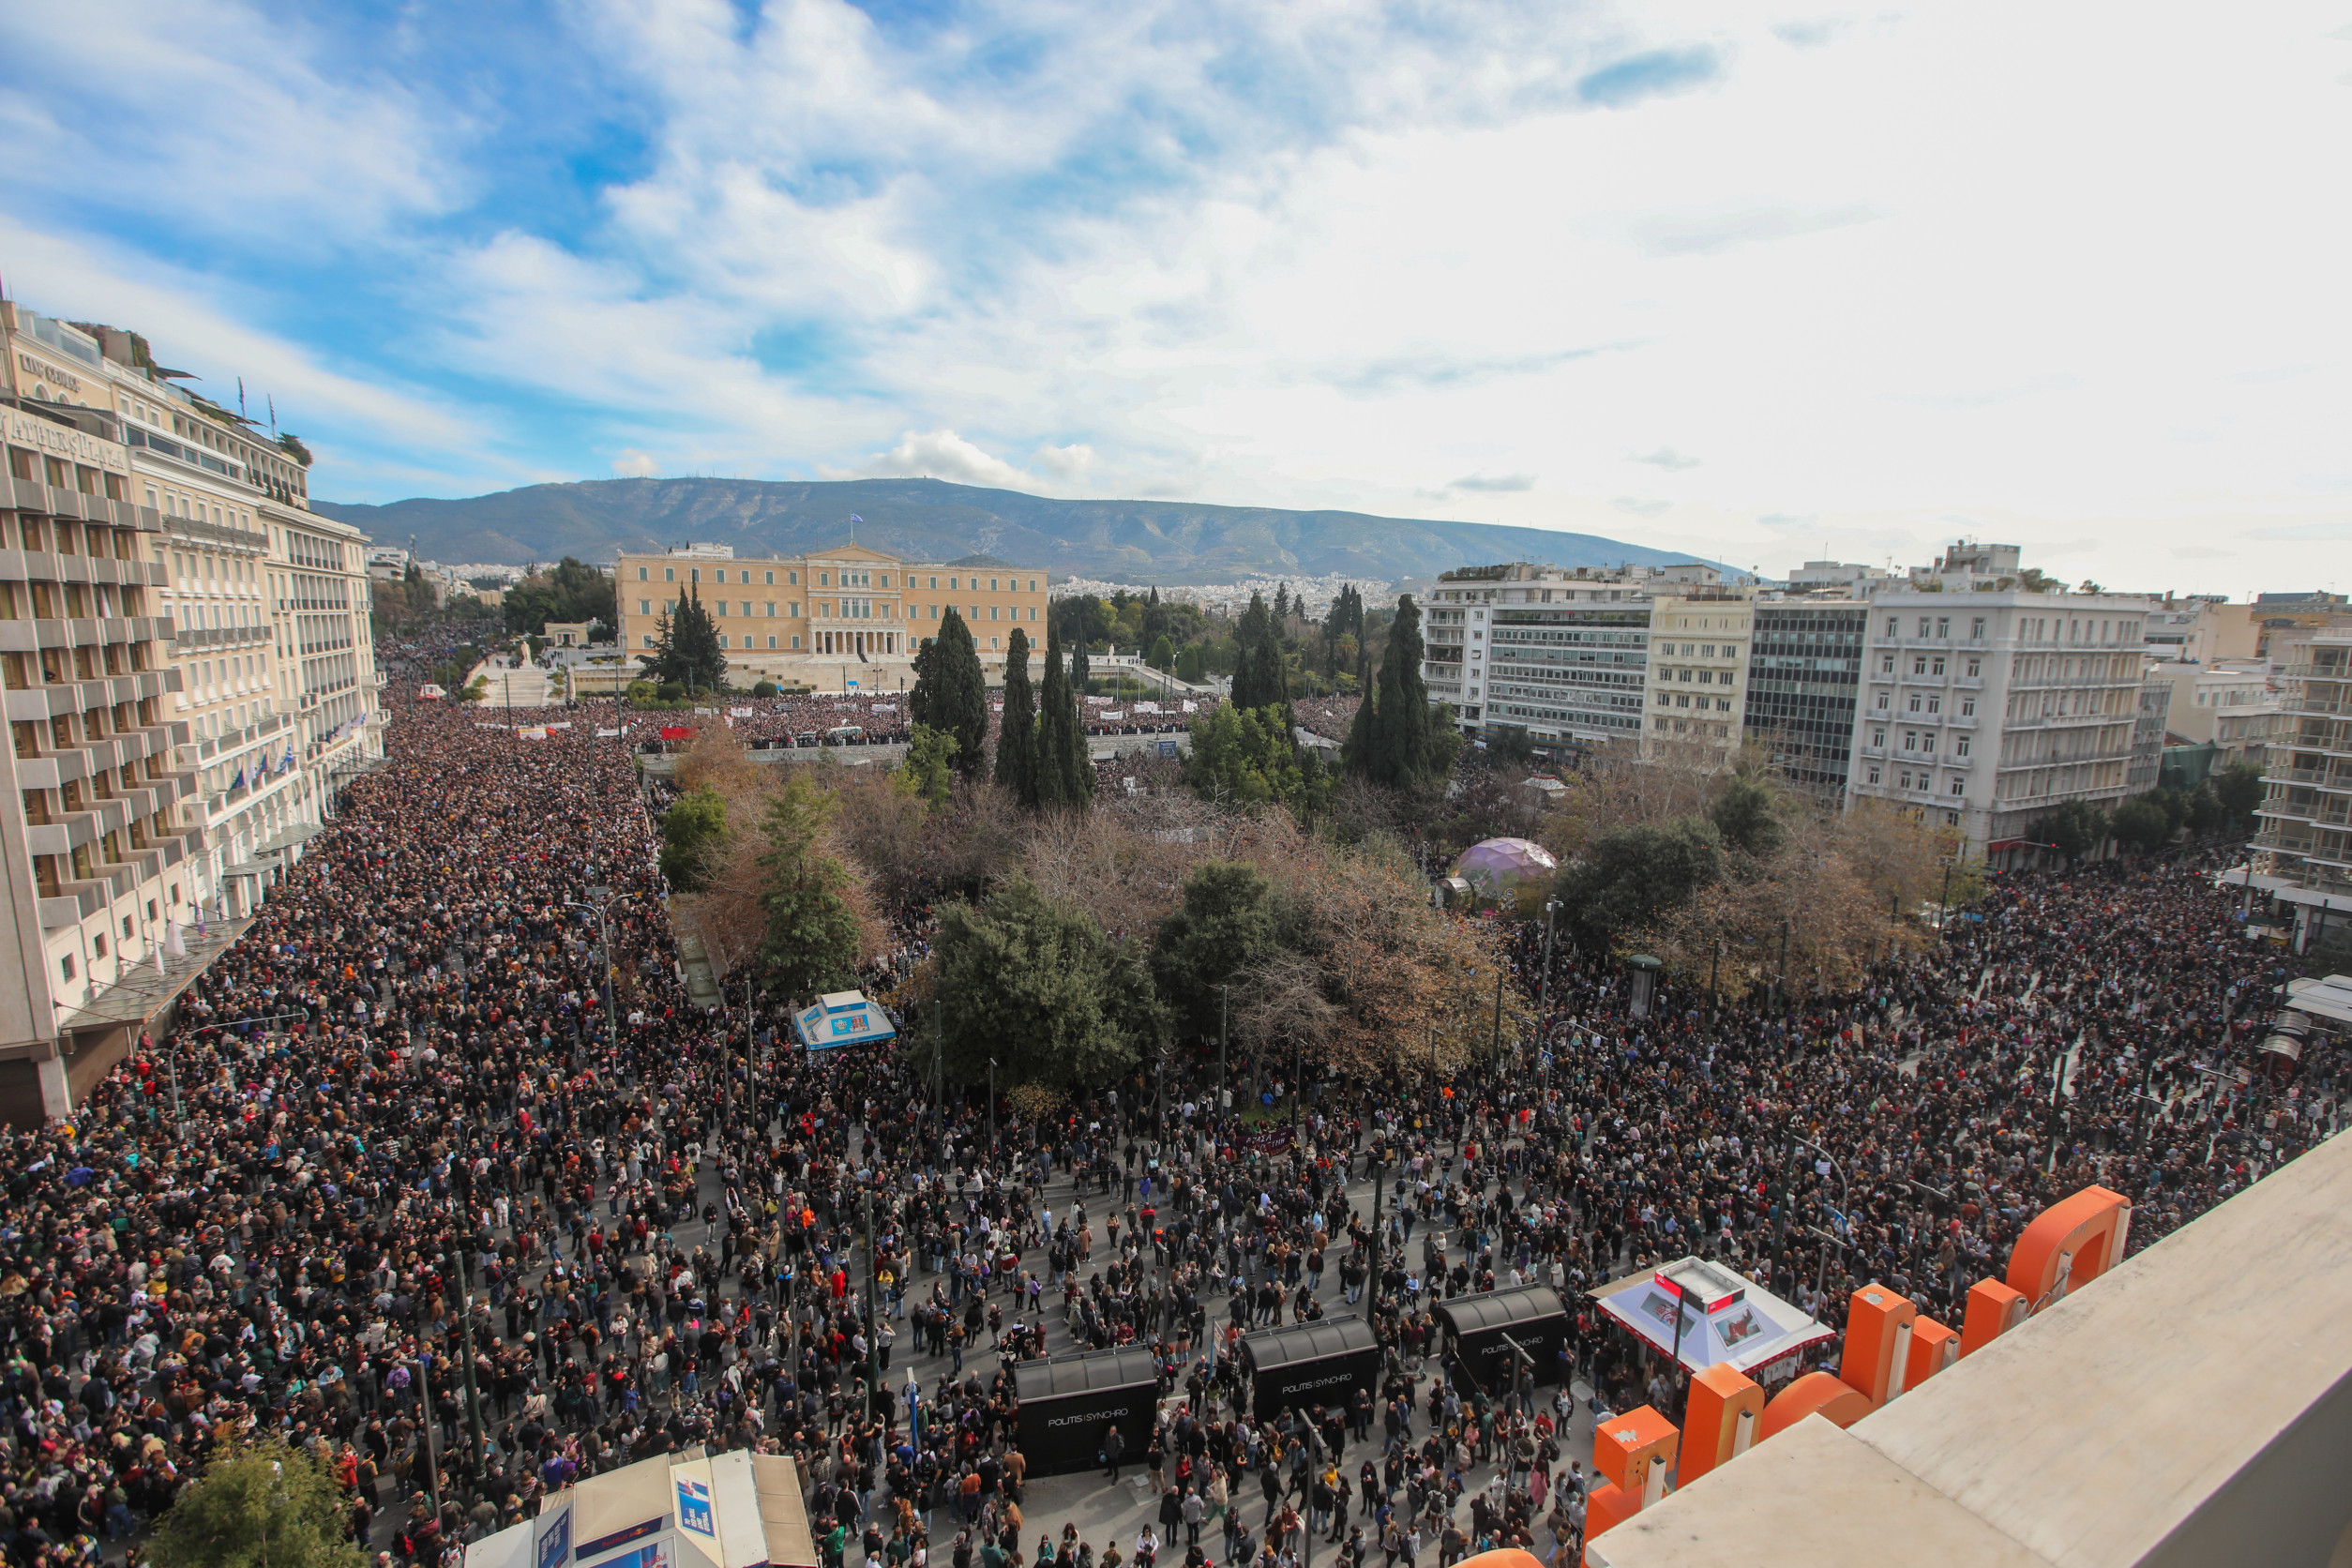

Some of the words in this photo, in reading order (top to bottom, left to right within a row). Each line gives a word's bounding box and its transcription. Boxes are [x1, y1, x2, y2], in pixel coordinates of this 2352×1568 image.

[20, 354, 44, 377] KING
[45, 367, 82, 393] GEORGE
[1481, 1343, 1509, 1356] POLITIS
[1282, 1381, 1313, 1395] POLITIS
[1315, 1373, 1352, 1387] SYNCHRO
[1048, 1414, 1083, 1427] POLITIS
[1085, 1408, 1129, 1422] SYNCHRO
